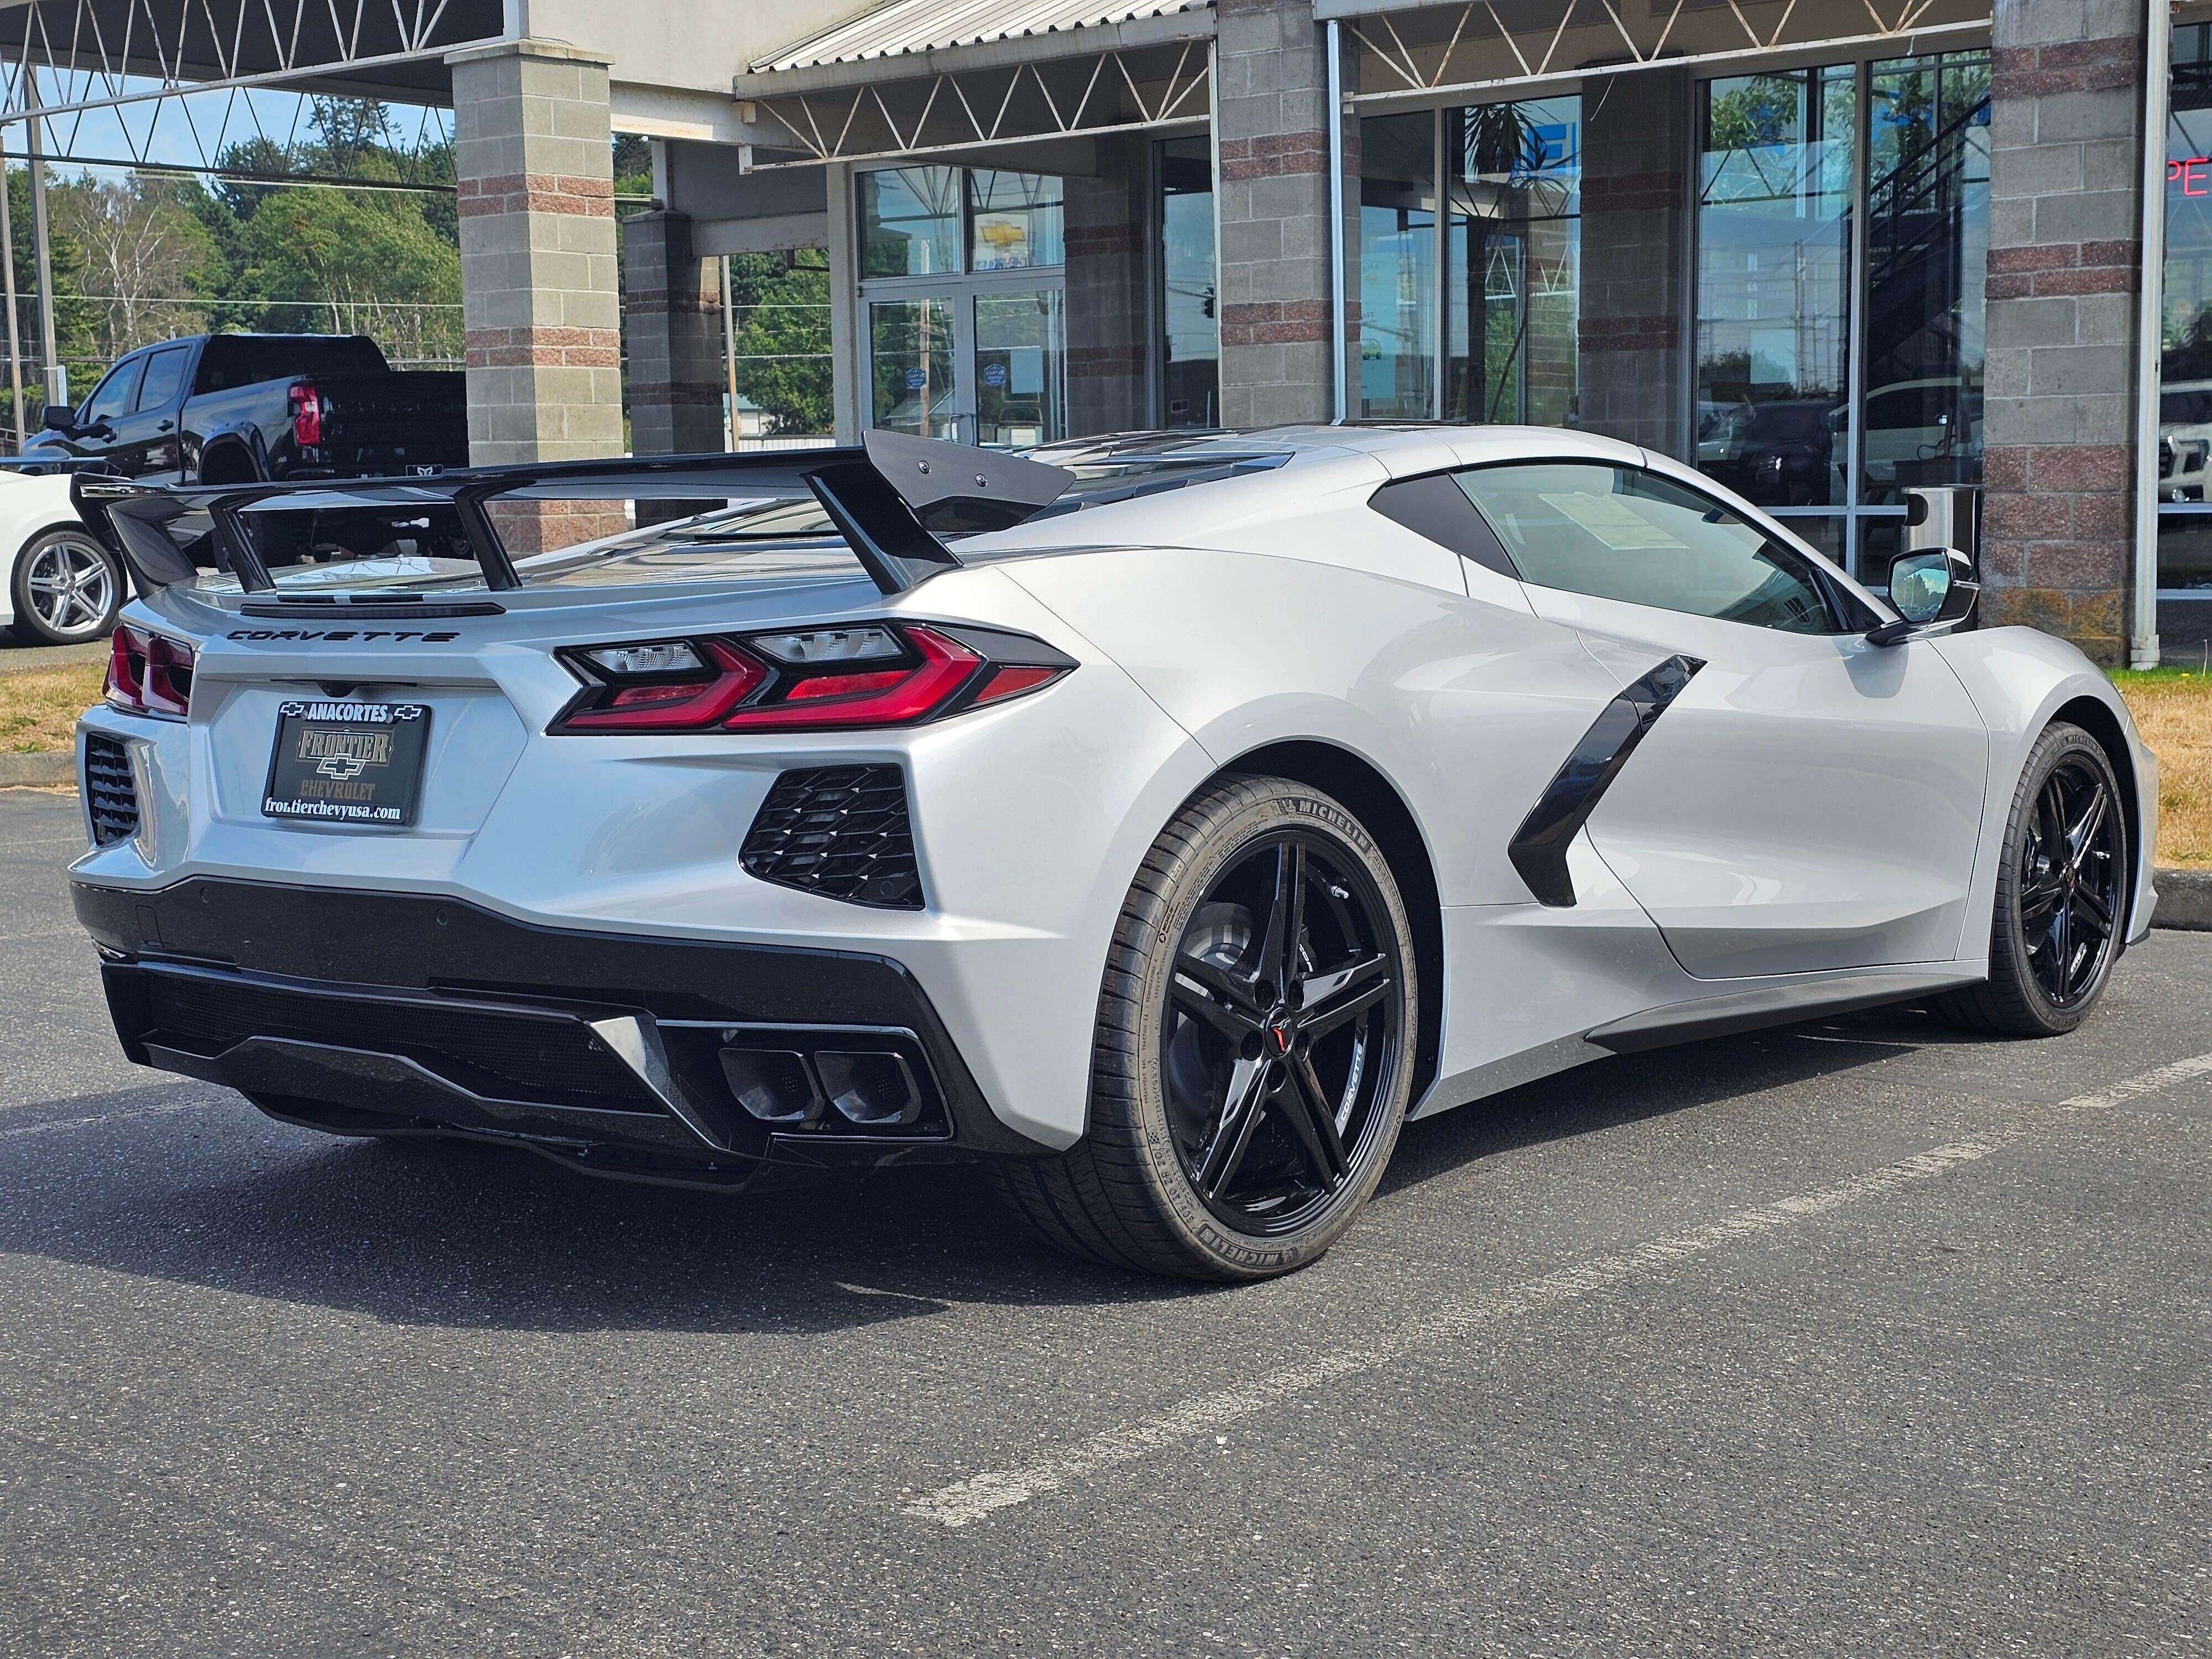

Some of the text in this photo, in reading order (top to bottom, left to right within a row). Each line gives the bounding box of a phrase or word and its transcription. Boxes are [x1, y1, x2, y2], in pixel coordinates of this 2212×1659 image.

[227, 630, 460, 642] CORVETTE
[307, 703, 388, 722] ANACORTES
[299, 730, 389, 763] FRONTIER
[300, 779, 375, 801] CHEVROLET
[1299, 800, 1368, 848] MICHELIN
[1341, 1042, 1363, 1121] CORVETTE
[1199, 1228, 1279, 1266] MICHELIN
